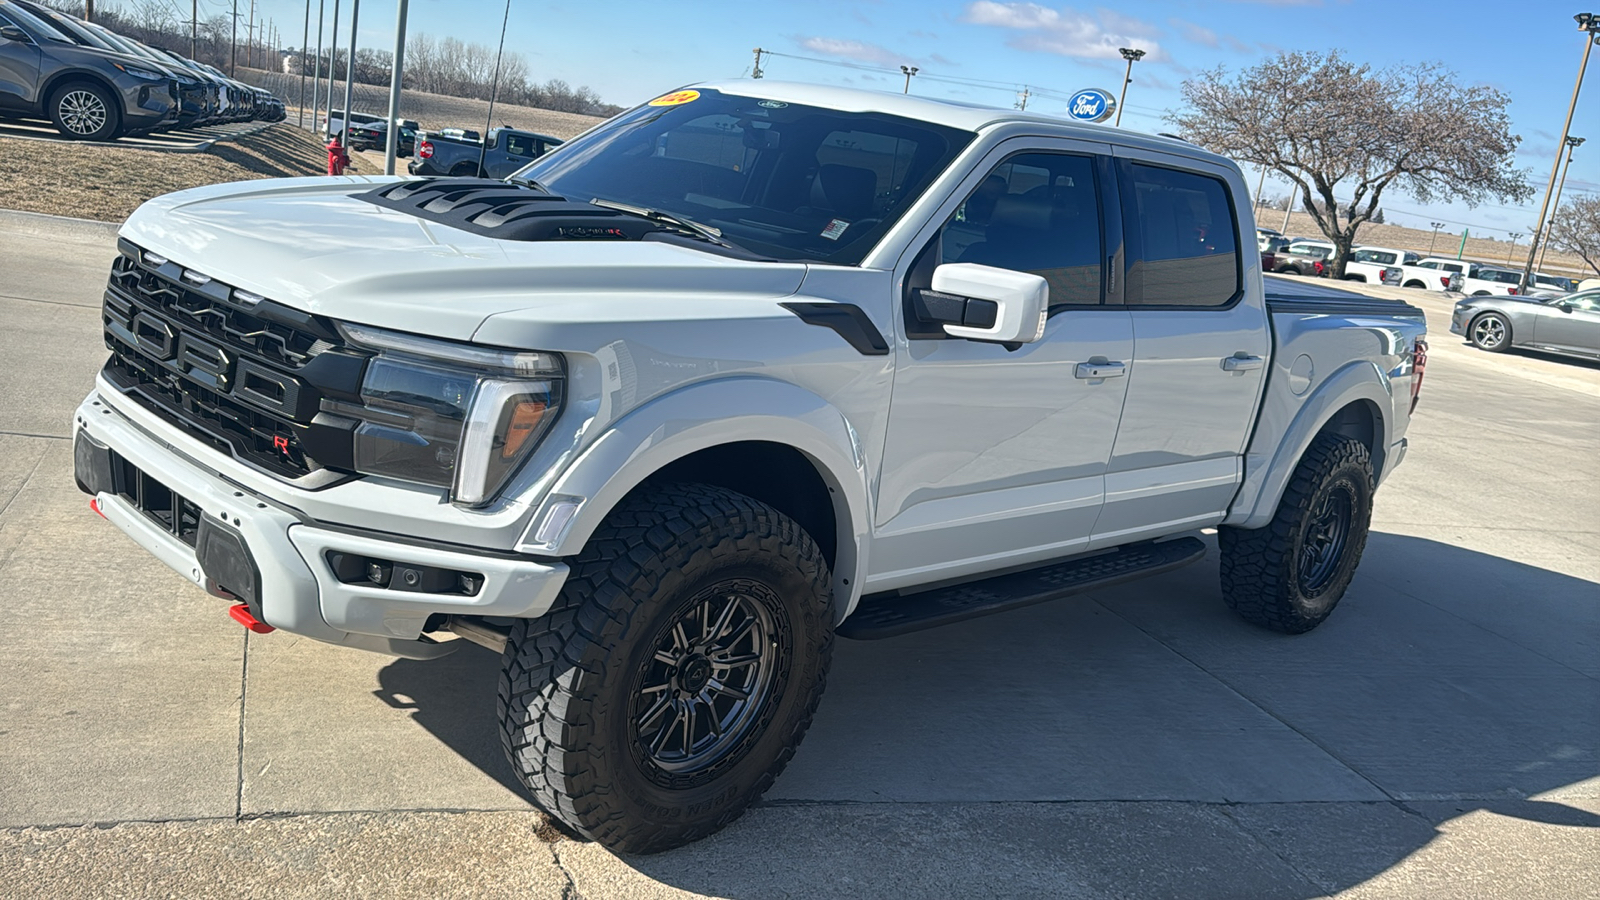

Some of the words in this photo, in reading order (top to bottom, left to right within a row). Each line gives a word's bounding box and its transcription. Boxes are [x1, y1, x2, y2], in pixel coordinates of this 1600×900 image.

[1073, 94, 1100, 115] Ford
[102, 290, 300, 418] FORD
[273, 435, 289, 454] R
[685, 785, 738, 818] OPEN
